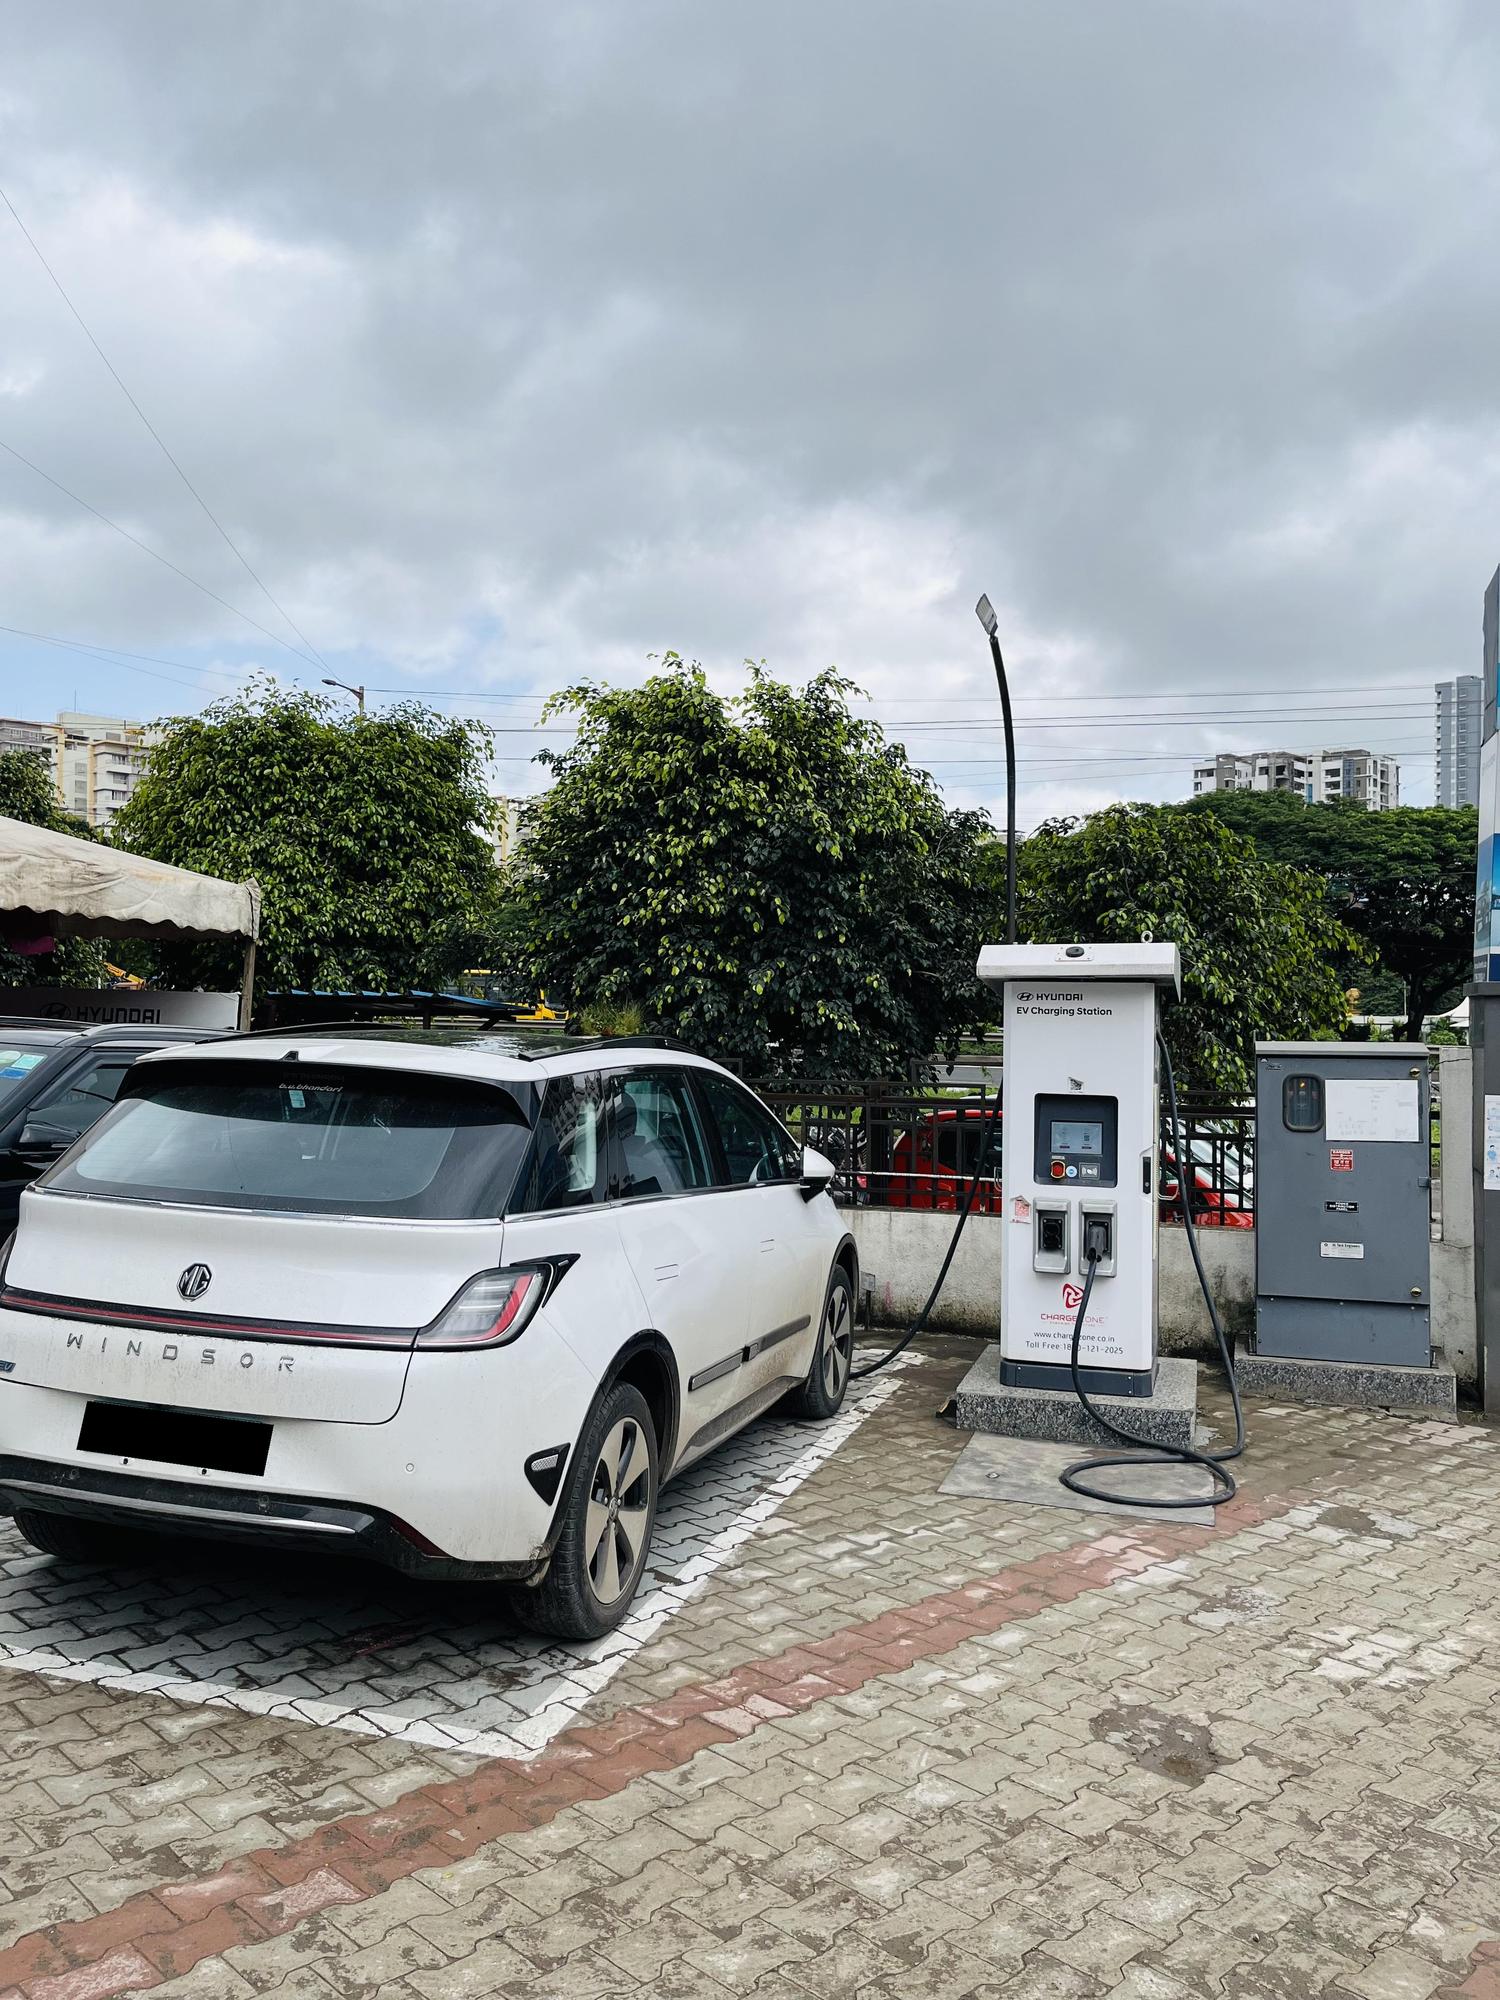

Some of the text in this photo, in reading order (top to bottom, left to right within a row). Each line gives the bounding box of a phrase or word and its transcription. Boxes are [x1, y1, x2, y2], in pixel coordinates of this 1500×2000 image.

[1036, 993, 1083, 1001] HYUNDAI
[76, 1006, 161, 1024] HYUNDAI
[1016, 1006, 1112, 1016] EV Charging Station
[179, 1264, 211, 1297] MG
[1040, 1313, 1105, 1324] CHARGEONE
[67, 1332, 295, 1373] WINDSOR
[1026, 1341, 1040, 1349] Toll
[1063, 1343, 1124, 1355] 180-121-2025
